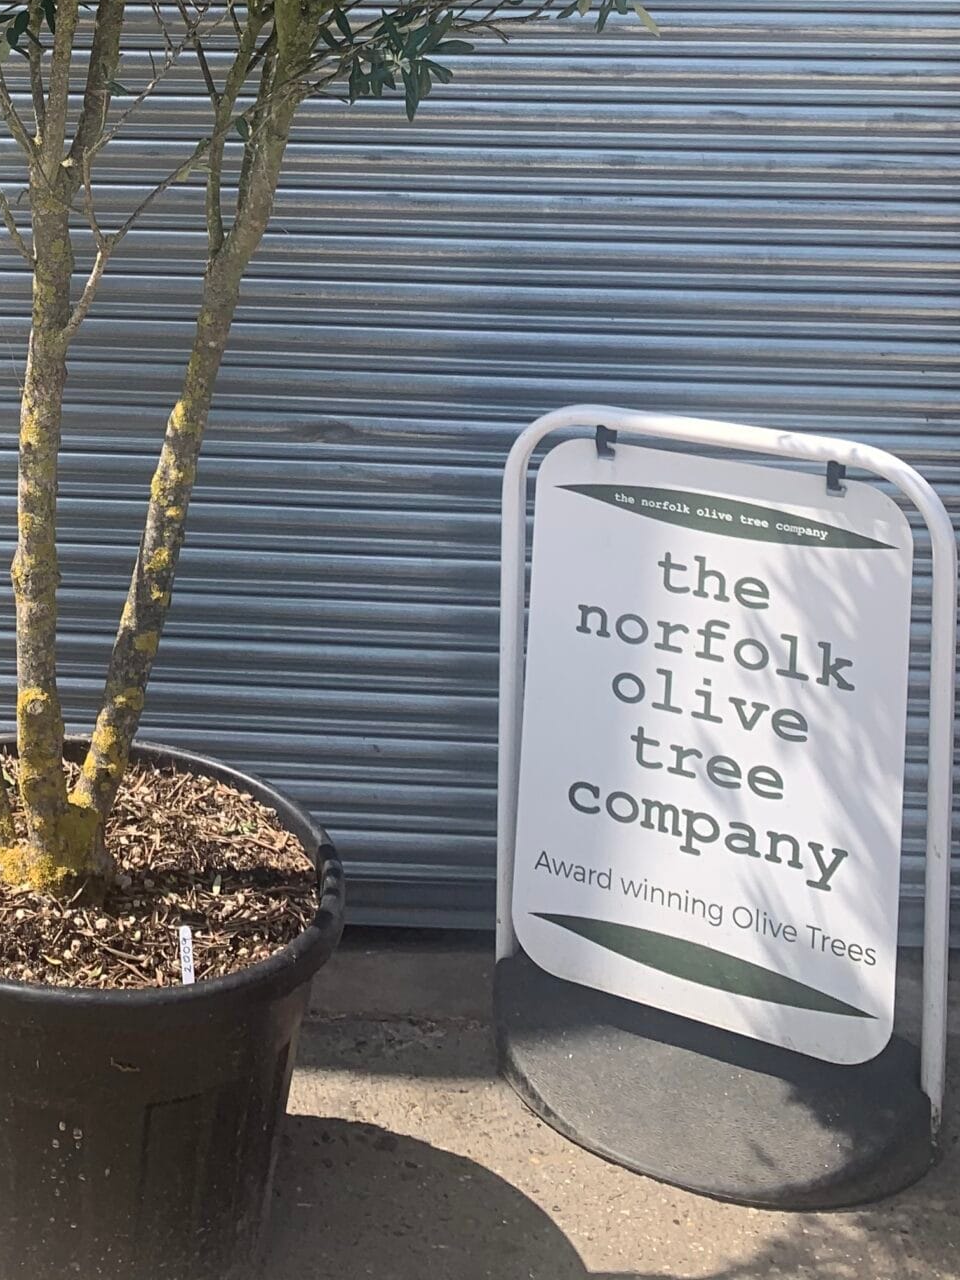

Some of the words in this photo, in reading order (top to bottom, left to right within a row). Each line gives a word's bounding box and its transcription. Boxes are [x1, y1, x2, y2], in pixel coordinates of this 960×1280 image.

[614, 492, 635, 505] the
[641, 498, 690, 514] norfolk
[696, 507, 733, 522] olive
[740, 514, 769, 528] tree
[775, 521, 828, 540] company
[657, 551, 770, 610] the
[575, 603, 856, 691] norfolk
[611, 668, 809, 742] olive
[630, 725, 784, 799] tree
[568, 781, 849, 891] company
[534, 850, 612, 890] Award
[620, 879, 723, 926] winning
[732, 906, 798, 942] Olive
[806, 924, 877, 966] Trees
